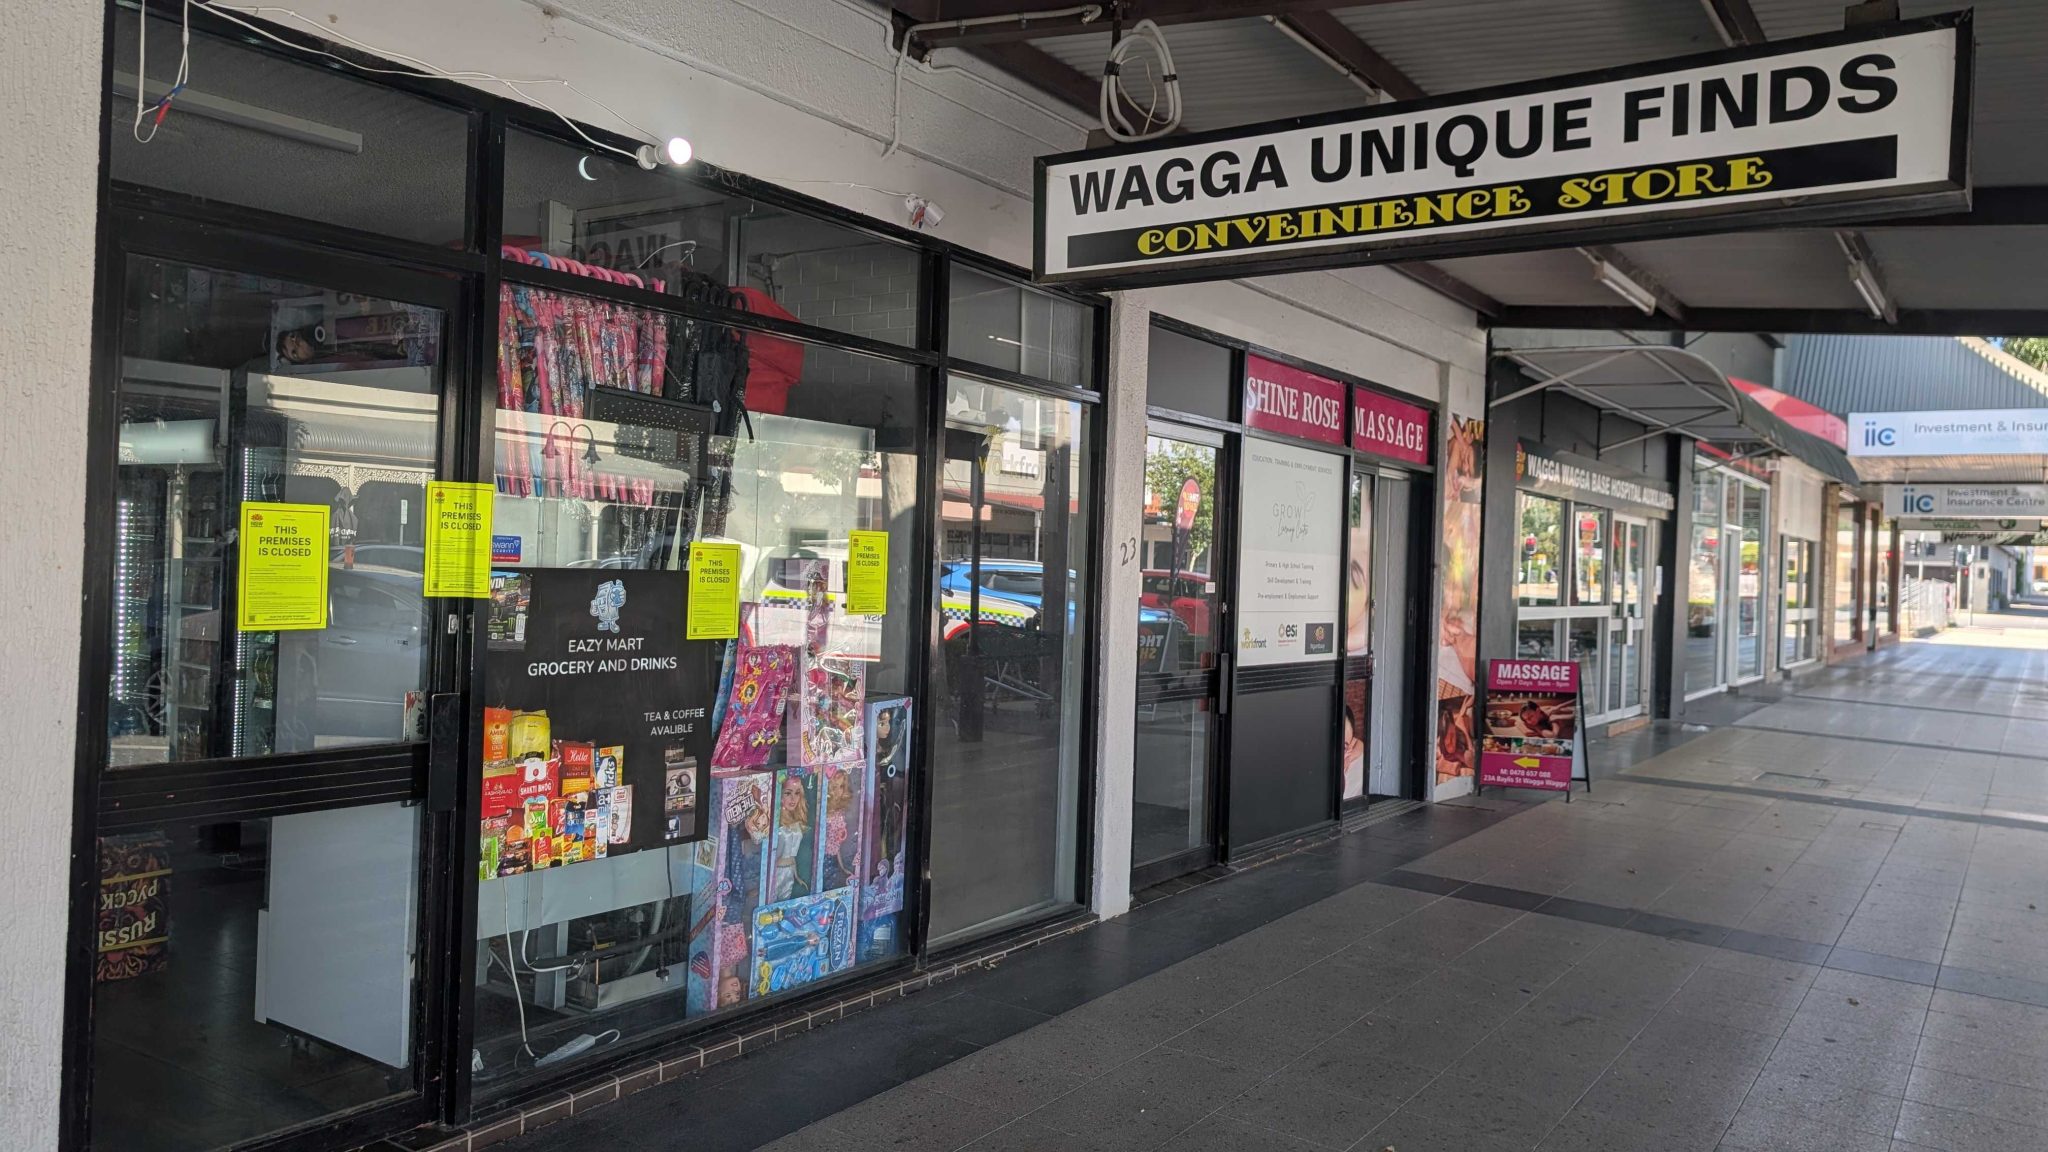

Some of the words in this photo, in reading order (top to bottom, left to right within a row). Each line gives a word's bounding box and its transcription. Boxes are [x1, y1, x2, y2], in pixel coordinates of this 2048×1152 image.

[1069, 144, 1288, 216] WAGGA
[1311, 97, 1592, 183] UNIQUE
[1624, 53, 1898, 143] FINDS
[1137, 185, 1531, 255] CONVEINIENCE
[1558, 156, 1773, 209] STORE
[1246, 376, 1298, 419] SHINE
[1302, 391, 1340, 430] ROSE
[1355, 405, 1423, 451] MASSAGE
[1914, 422, 1992, 433] Investment
[1997, 421, 2007, 432] &
[2012, 421, 2048, 433] Insur
[1527, 453, 1561, 482] WAGGA
[1561, 464, 1591, 491] WAGGA
[1591, 472, 1611, 496] BASE
[1611, 478, 1643, 503] HOSPITAL
[1947, 488, 2008, 497] Investment
[2011, 488, 2019, 496] &
[453, 502, 473, 511] THIS
[1947, 497, 2001, 506] Insurance
[2006, 497, 2045, 506] Centre
[441, 512, 482, 521] PREMISES
[274, 525, 297, 535] THIS
[440, 521, 449, 530] IS
[451, 522, 482, 531] CLOSED
[259, 537, 311, 546] PREMISES
[492, 541, 515, 550] wann
[258, 547, 268, 556] IS
[270, 547, 311, 557] CLOSED
[1120, 537, 1137, 566] 23
[1285, 624, 1298, 638] esi
[568, 638, 603, 653] EAZY
[606, 637, 644, 651] MART
[527, 660, 595, 676] GROCERY
[598, 658, 627, 673] AND
[630, 657, 677, 671] DRINKS
[1498, 664, 1570, 681] MASSAGE
[1496, 679, 1513, 687] Open
[644, 711, 662, 722] TEA
[664, 710, 671, 720] &
[672, 708, 705, 719] COFFEE
[650, 723, 693, 736] AVALIBLE
[1497, 775, 1514, 784] Baylis
[1523, 777, 1544, 786] Wagga
